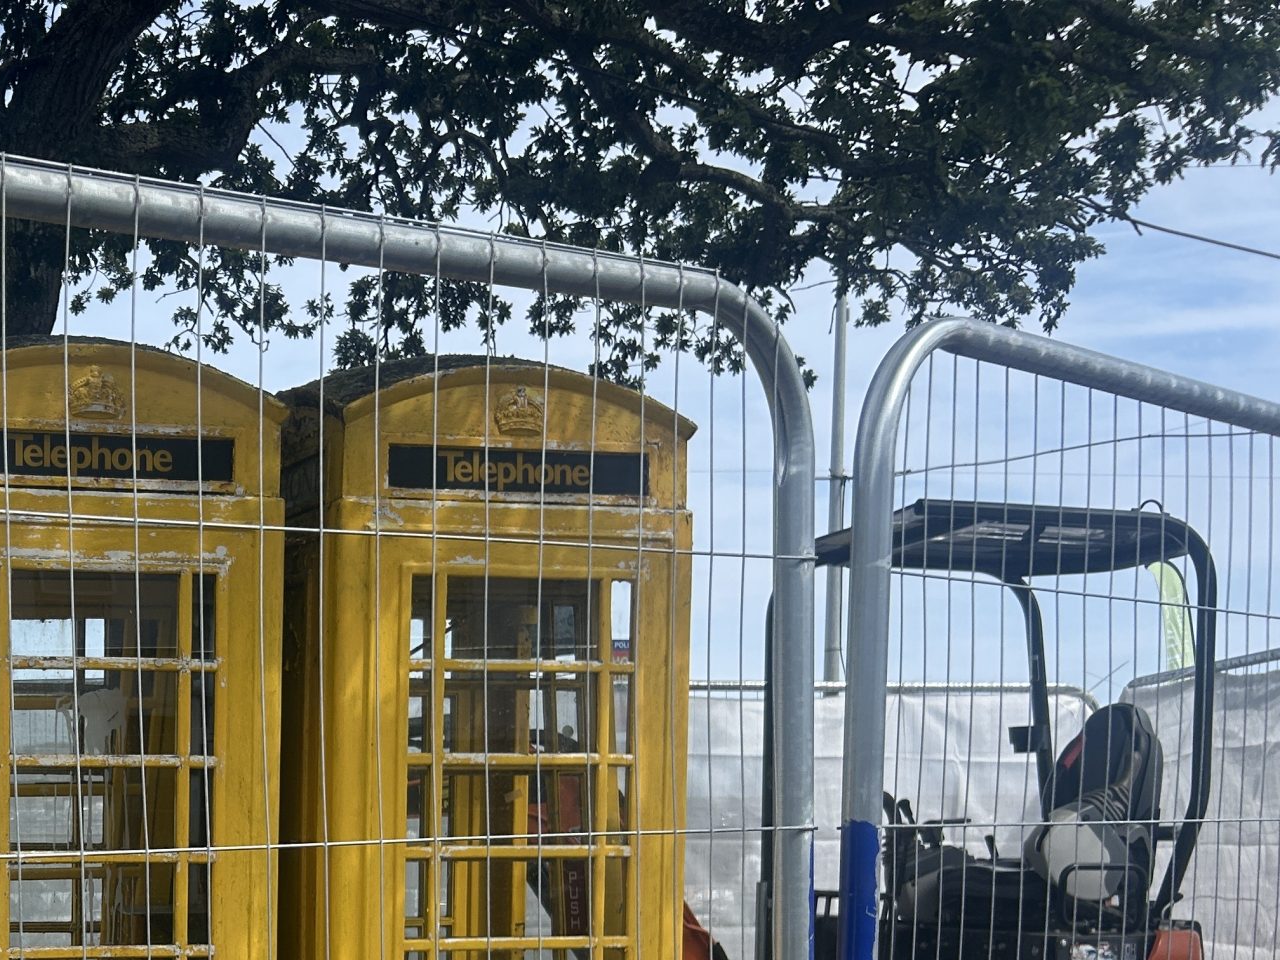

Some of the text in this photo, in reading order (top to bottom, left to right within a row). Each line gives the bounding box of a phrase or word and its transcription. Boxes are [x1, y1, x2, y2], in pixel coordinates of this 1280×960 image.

[8, 433, 173, 477] Telephone
[437, 450, 590, 491] Telephone
[568, 871, 580, 929] PUSH
